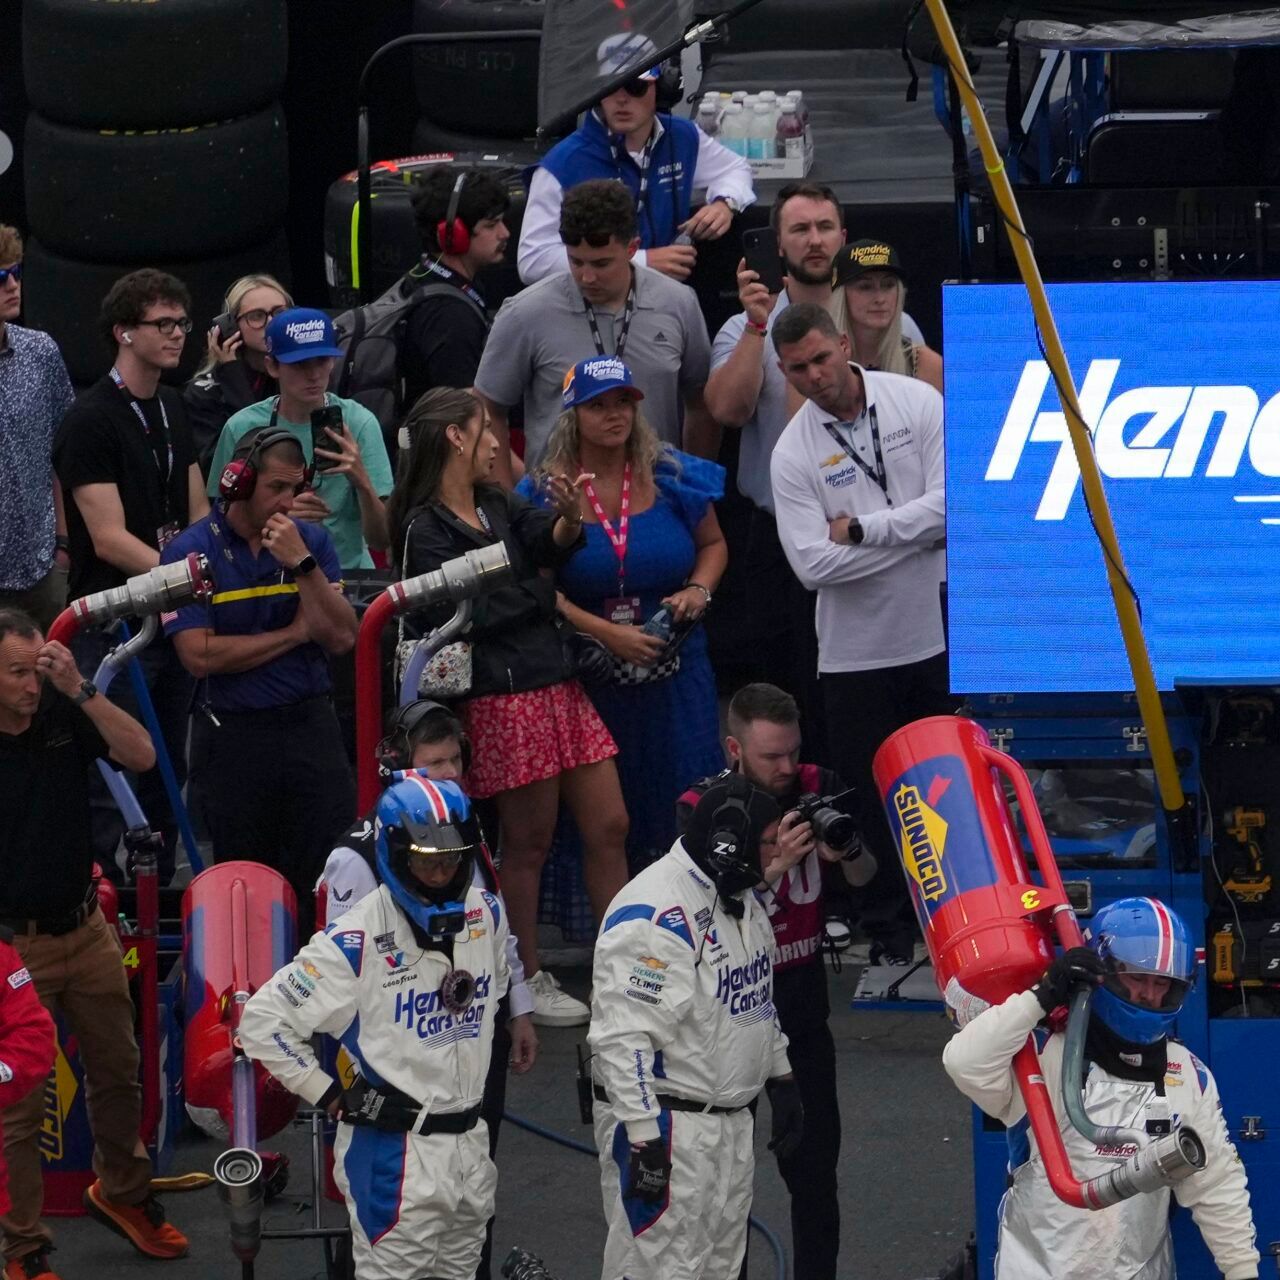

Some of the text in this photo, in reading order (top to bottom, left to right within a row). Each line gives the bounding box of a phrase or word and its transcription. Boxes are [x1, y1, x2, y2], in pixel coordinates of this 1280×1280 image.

[286, 317, 326, 335] Hendrick
[583, 358, 624, 375] Hendrick
[825, 465, 857, 485] Hendrick
[895, 785, 946, 899] SUNOCO
[1020, 889, 1041, 910] 3
[121, 946, 140, 969] 4
[772, 936, 822, 966] DRIVE
[1266, 957, 1280, 970] 5
[382, 974, 418, 989] GOODYEAR
[629, 975, 663, 993] CLIMB
[633, 966, 666, 983] SIEMENS
[287, 973, 312, 999] CLIMB
[395, 968, 492, 1030] Henck
